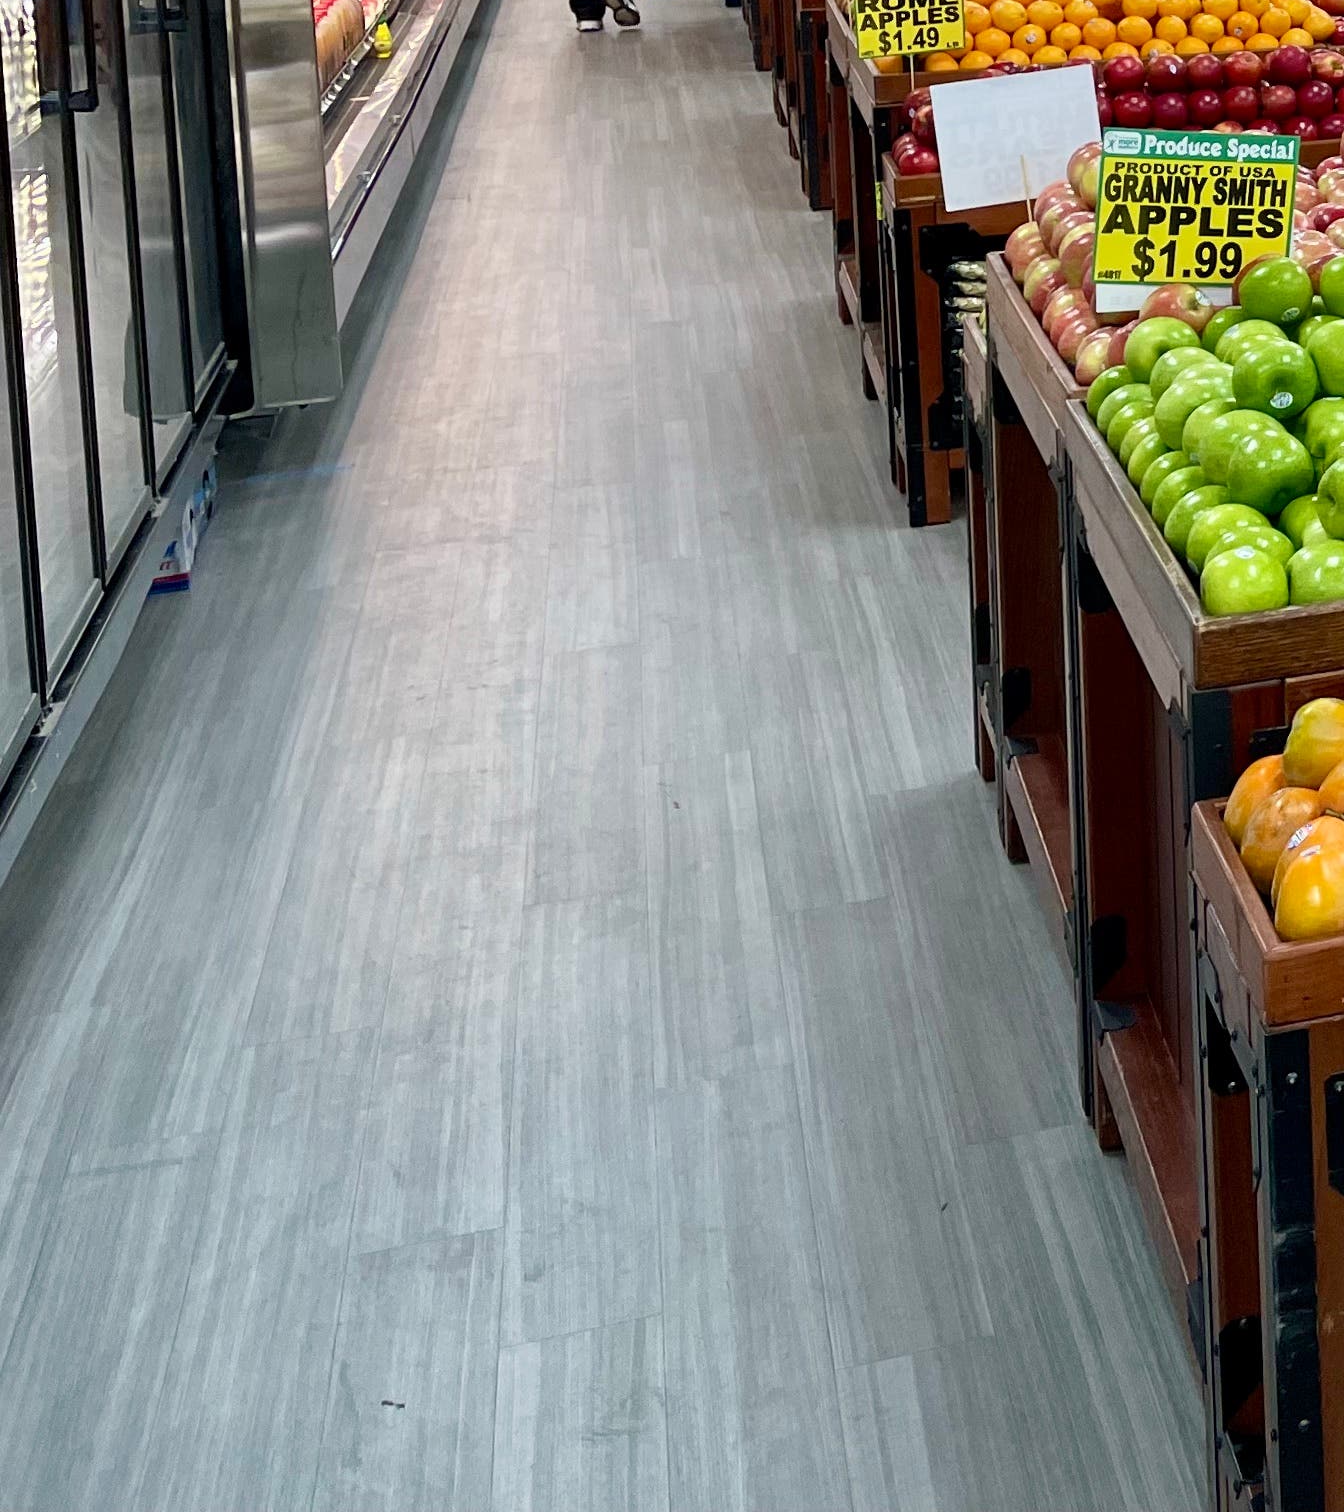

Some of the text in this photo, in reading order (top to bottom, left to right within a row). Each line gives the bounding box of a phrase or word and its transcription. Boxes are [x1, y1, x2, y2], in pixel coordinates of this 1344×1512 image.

[860, 6, 960, 31] APPLES
[879, 27, 939, 56] $1.49
[1144, 135, 1222, 157] Produce
[1227, 138, 1295, 162] Special
[1114, 162, 1276, 178] PRODUCT OF USA
[1104, 174, 1288, 207] GRANNY SMITH
[1101, 204, 1284, 238] APPLES
[1131, 237, 1243, 282] $1.99
